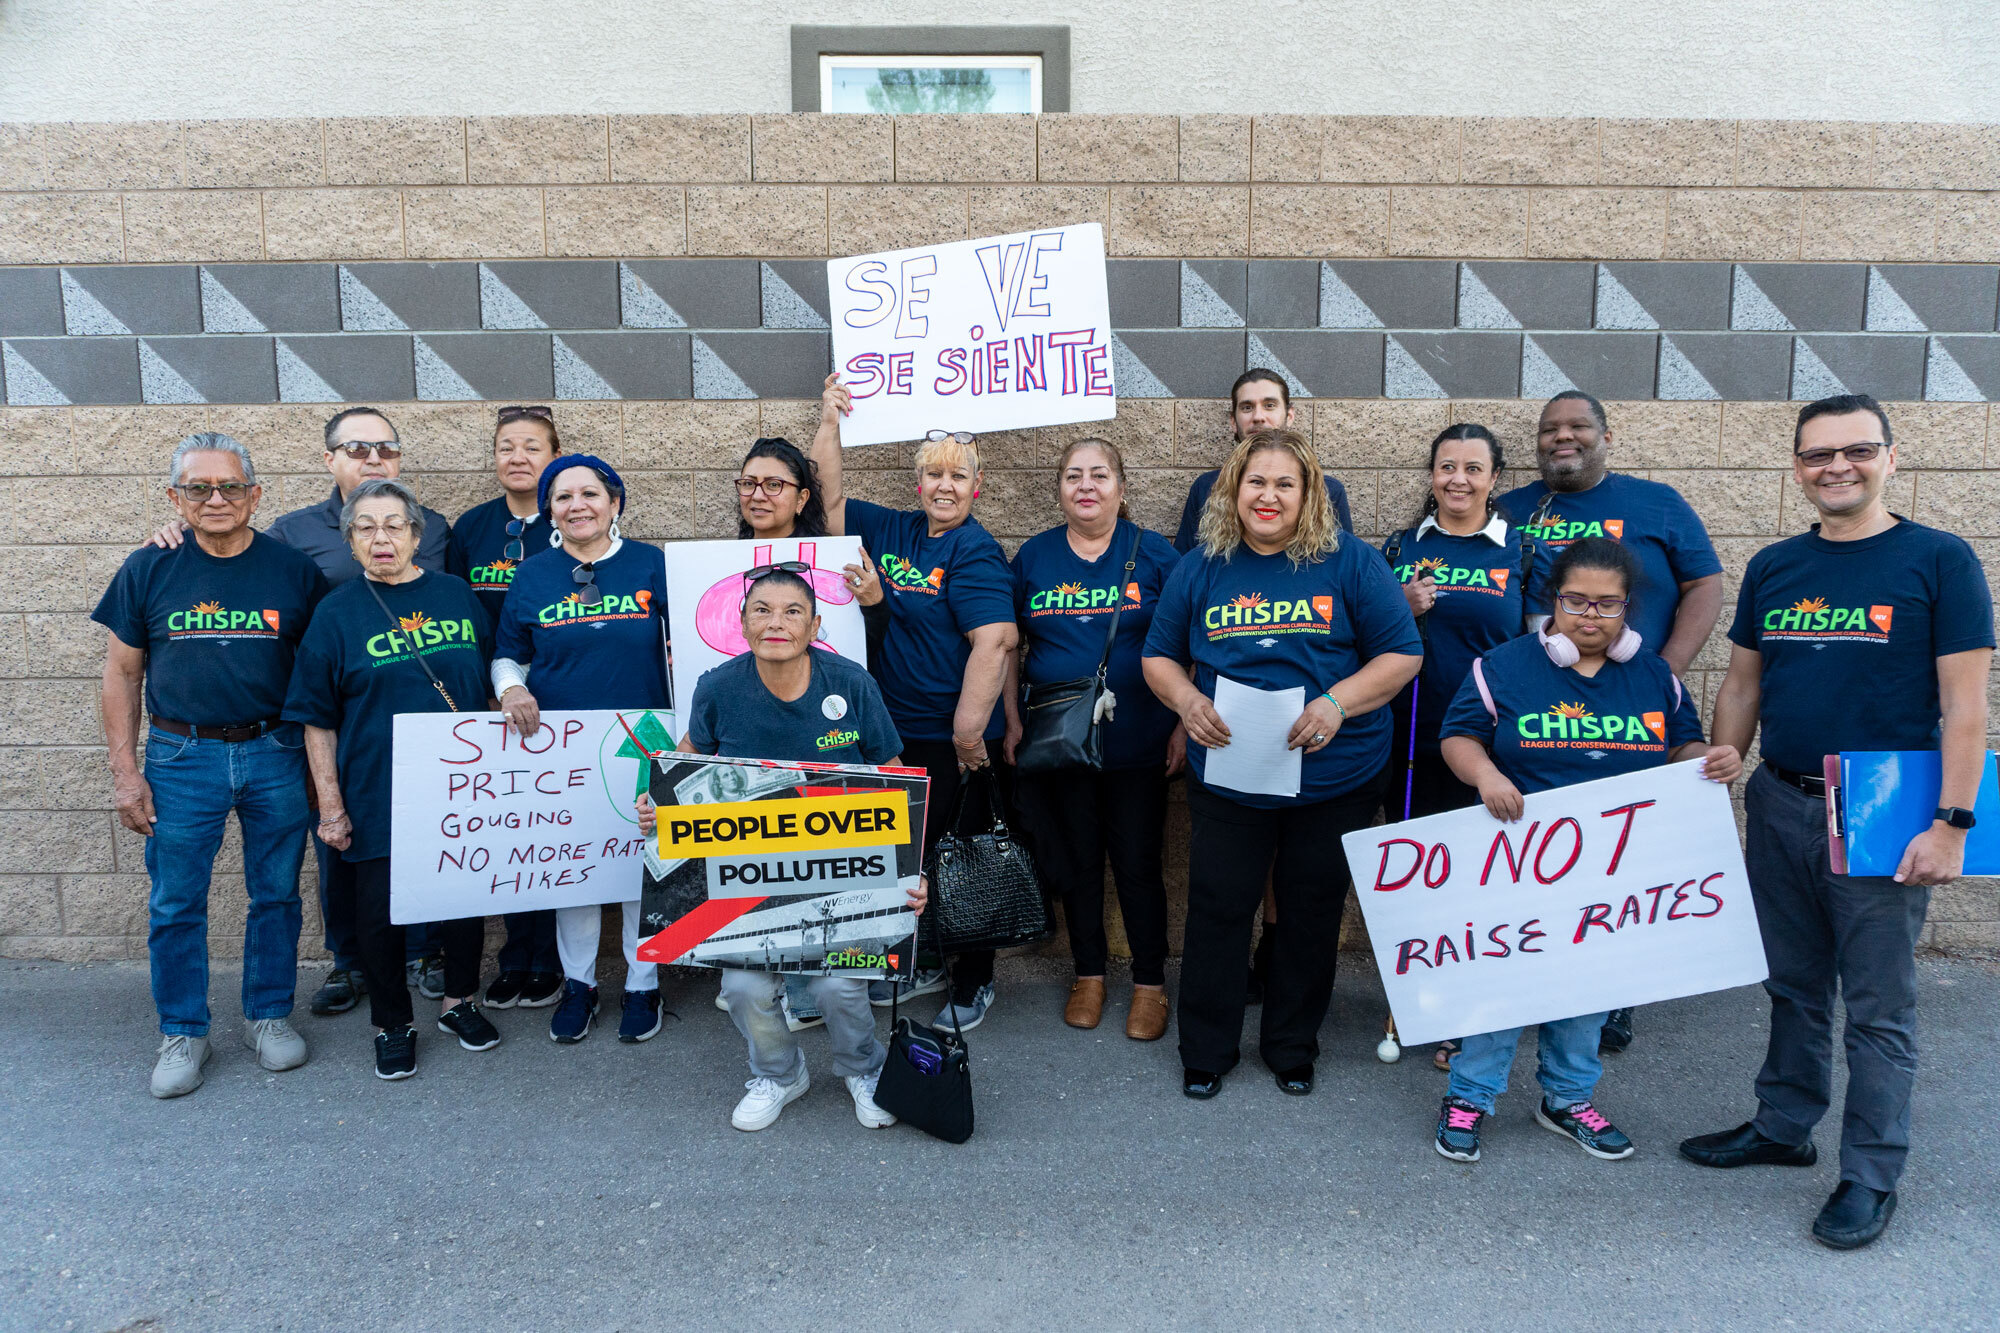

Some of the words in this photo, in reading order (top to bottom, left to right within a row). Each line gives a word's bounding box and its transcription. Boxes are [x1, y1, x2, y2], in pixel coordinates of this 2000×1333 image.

[844, 255, 938, 339] SE
[975, 232, 1064, 332] VE
[844, 351, 914, 399] SE
[1476, 587, 1504, 597] VOTERS
[577, 613, 629, 623] CONSERVATION
[1031, 609, 1054, 618] LEAGUE
[1065, 607, 1114, 615] CONSERVATION
[1121, 603, 1141, 612] OTERS
[372, 655, 401, 668] LEAGUE
[410, 643, 462, 660] CNSERVATION
[439, 718, 584, 765] STOP
[1520, 740, 1556, 748] LEAGUE
[1556, 741, 1569, 749] OF
[1570, 741, 1637, 751] CONSERVATION
[1637, 744, 1665, 752] VOTERS
[448, 767, 592, 801] PRICE
[670, 813, 799, 845] PEOPLE
[804, 807, 897, 836] OVER
[438, 846, 490, 873] NO
[508, 841, 594, 865] MORE
[601, 837, 646, 859] RAT
[1373, 838, 1451, 892] DO
[1480, 799, 1657, 886] NOT
[490, 865, 597, 894] HIKES
[718, 855, 886, 886] POLLUTERS
[1572, 872, 1725, 944] RATES
